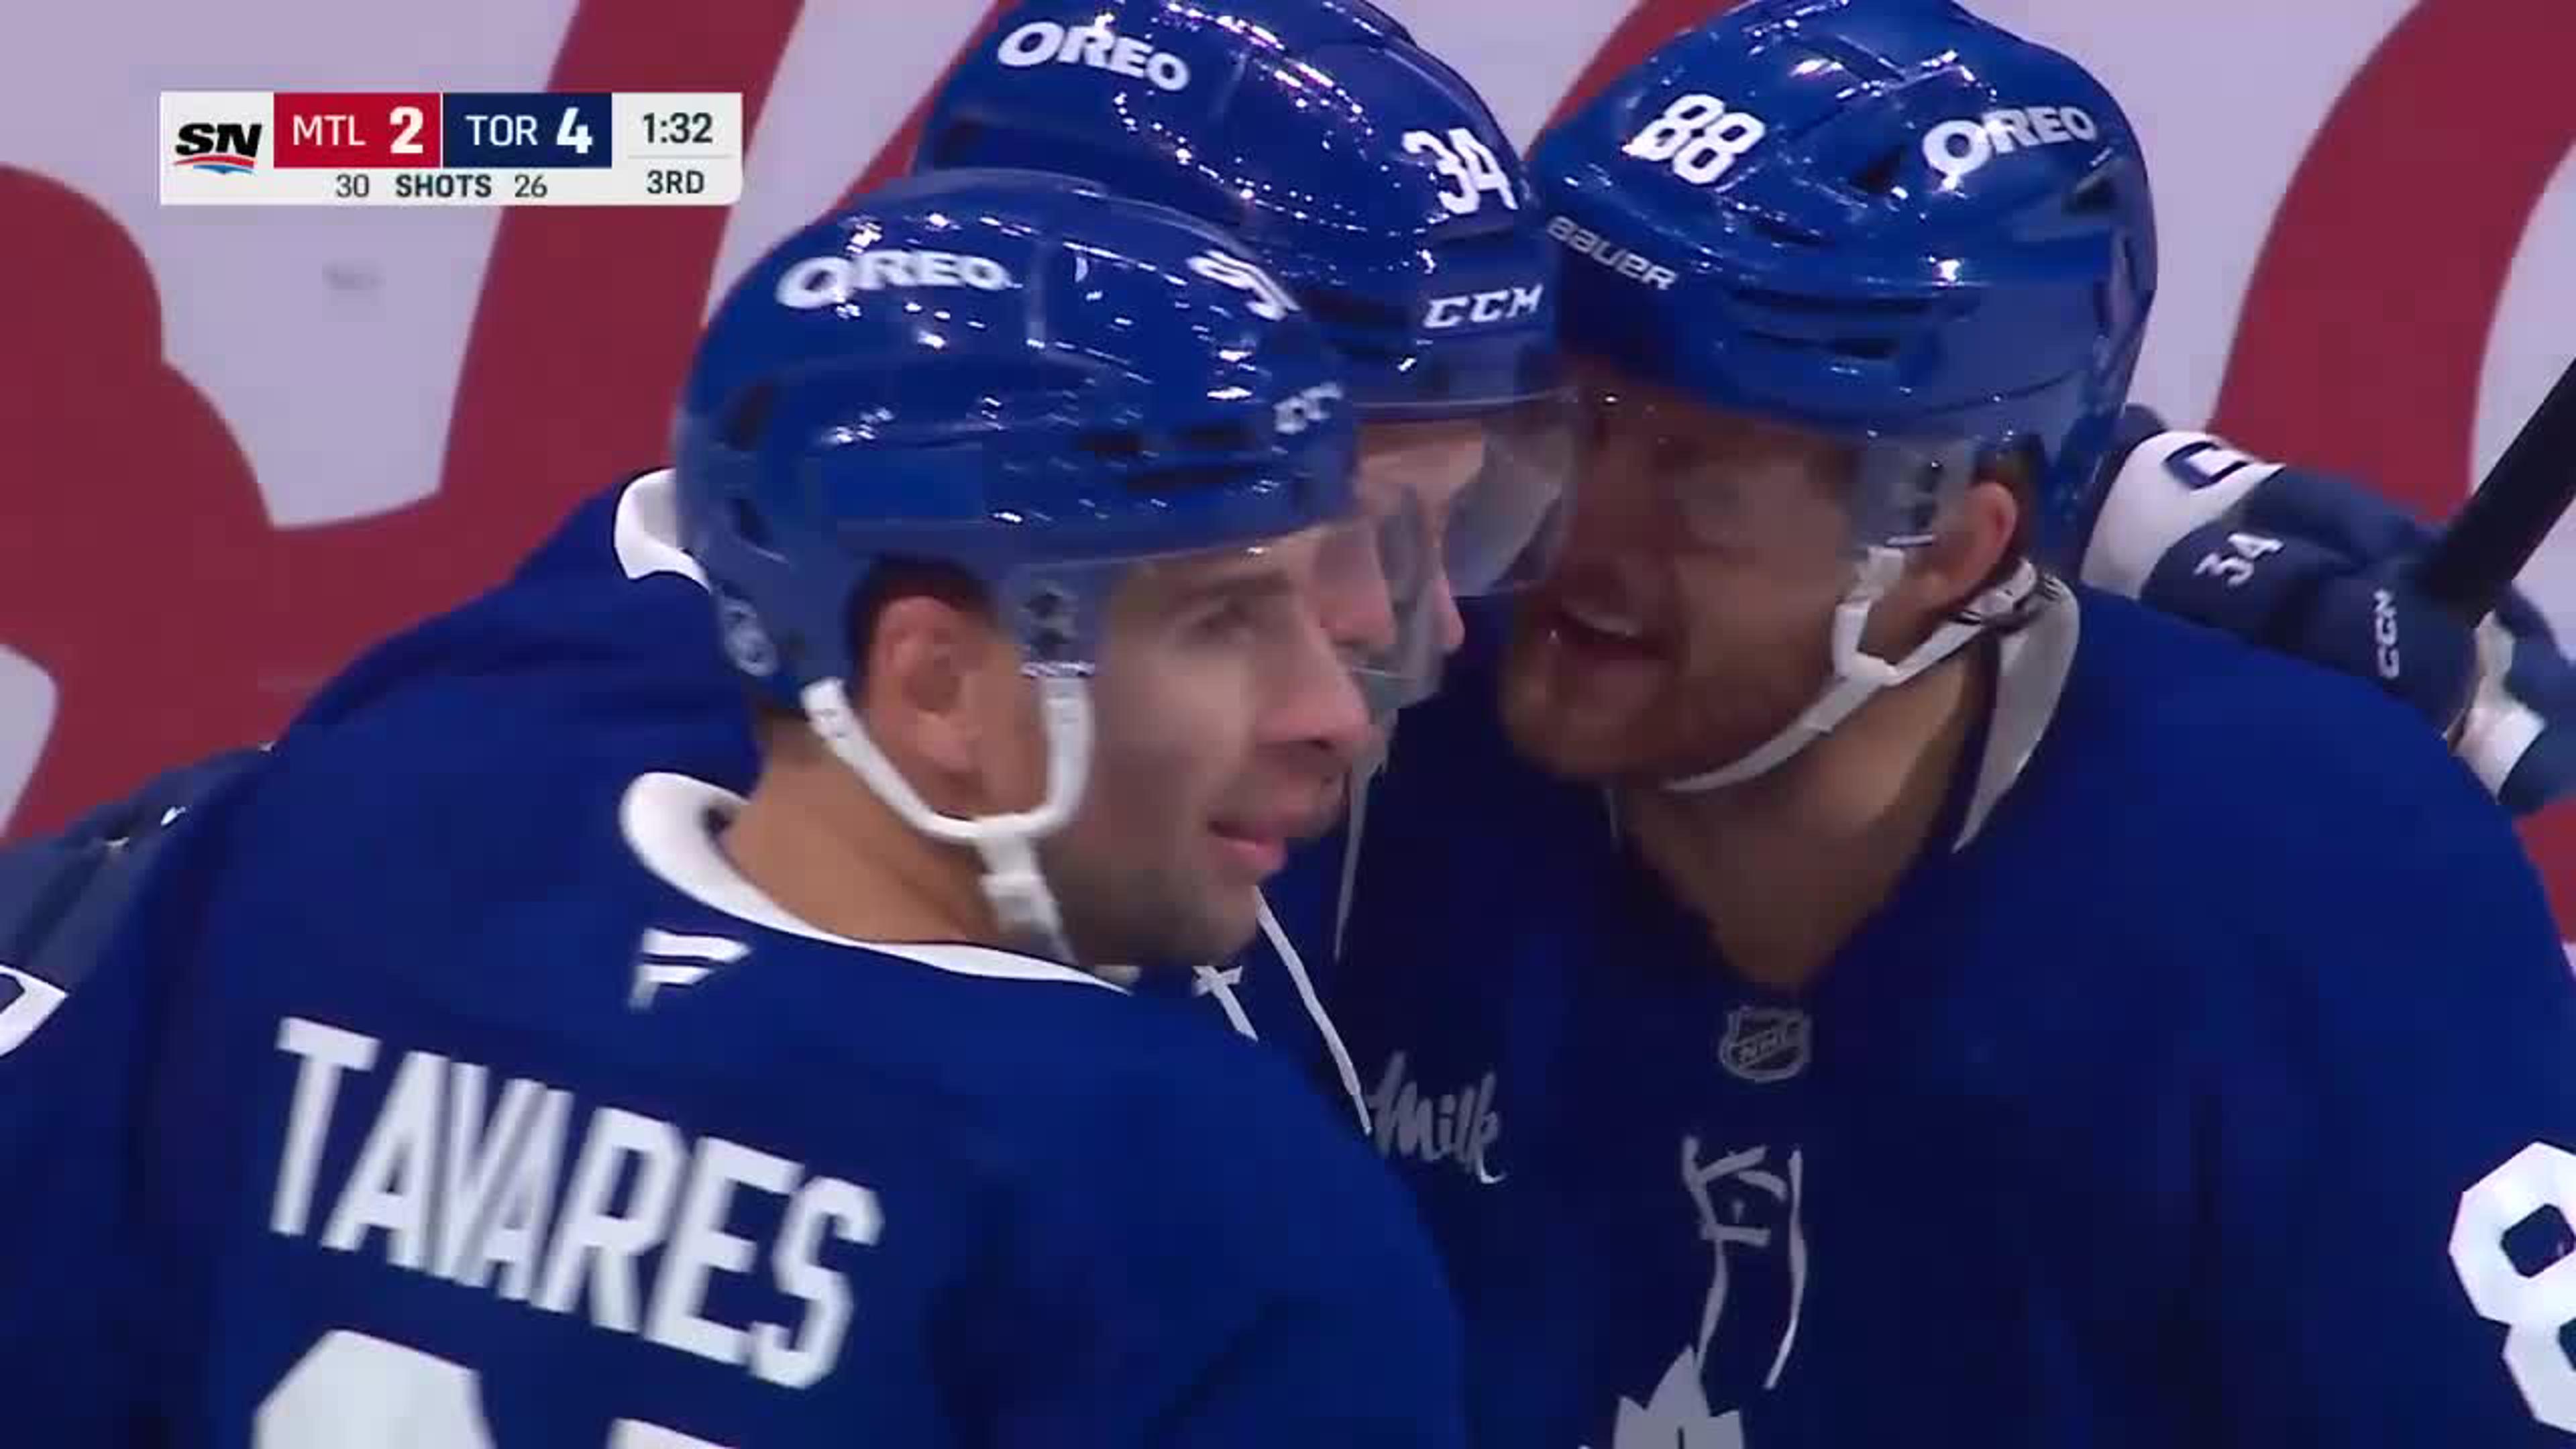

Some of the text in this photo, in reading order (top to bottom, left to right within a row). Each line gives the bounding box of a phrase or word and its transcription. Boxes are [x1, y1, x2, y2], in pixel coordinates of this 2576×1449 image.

[997, 21, 1191, 91] OREO
[1403, 127, 1518, 215] 34
[1626, 93, 1766, 185] 88
[1923, 107, 2096, 178] OREO
[775, 250, 1013, 310] OREO
[1546, 215, 1678, 290] BAUER
[1423, 283, 1544, 329] CCM
[2193, 532, 2284, 588] 34
[1366, 1051, 1508, 1185] Milk
[270, 1016, 885, 1390] TAVARES
